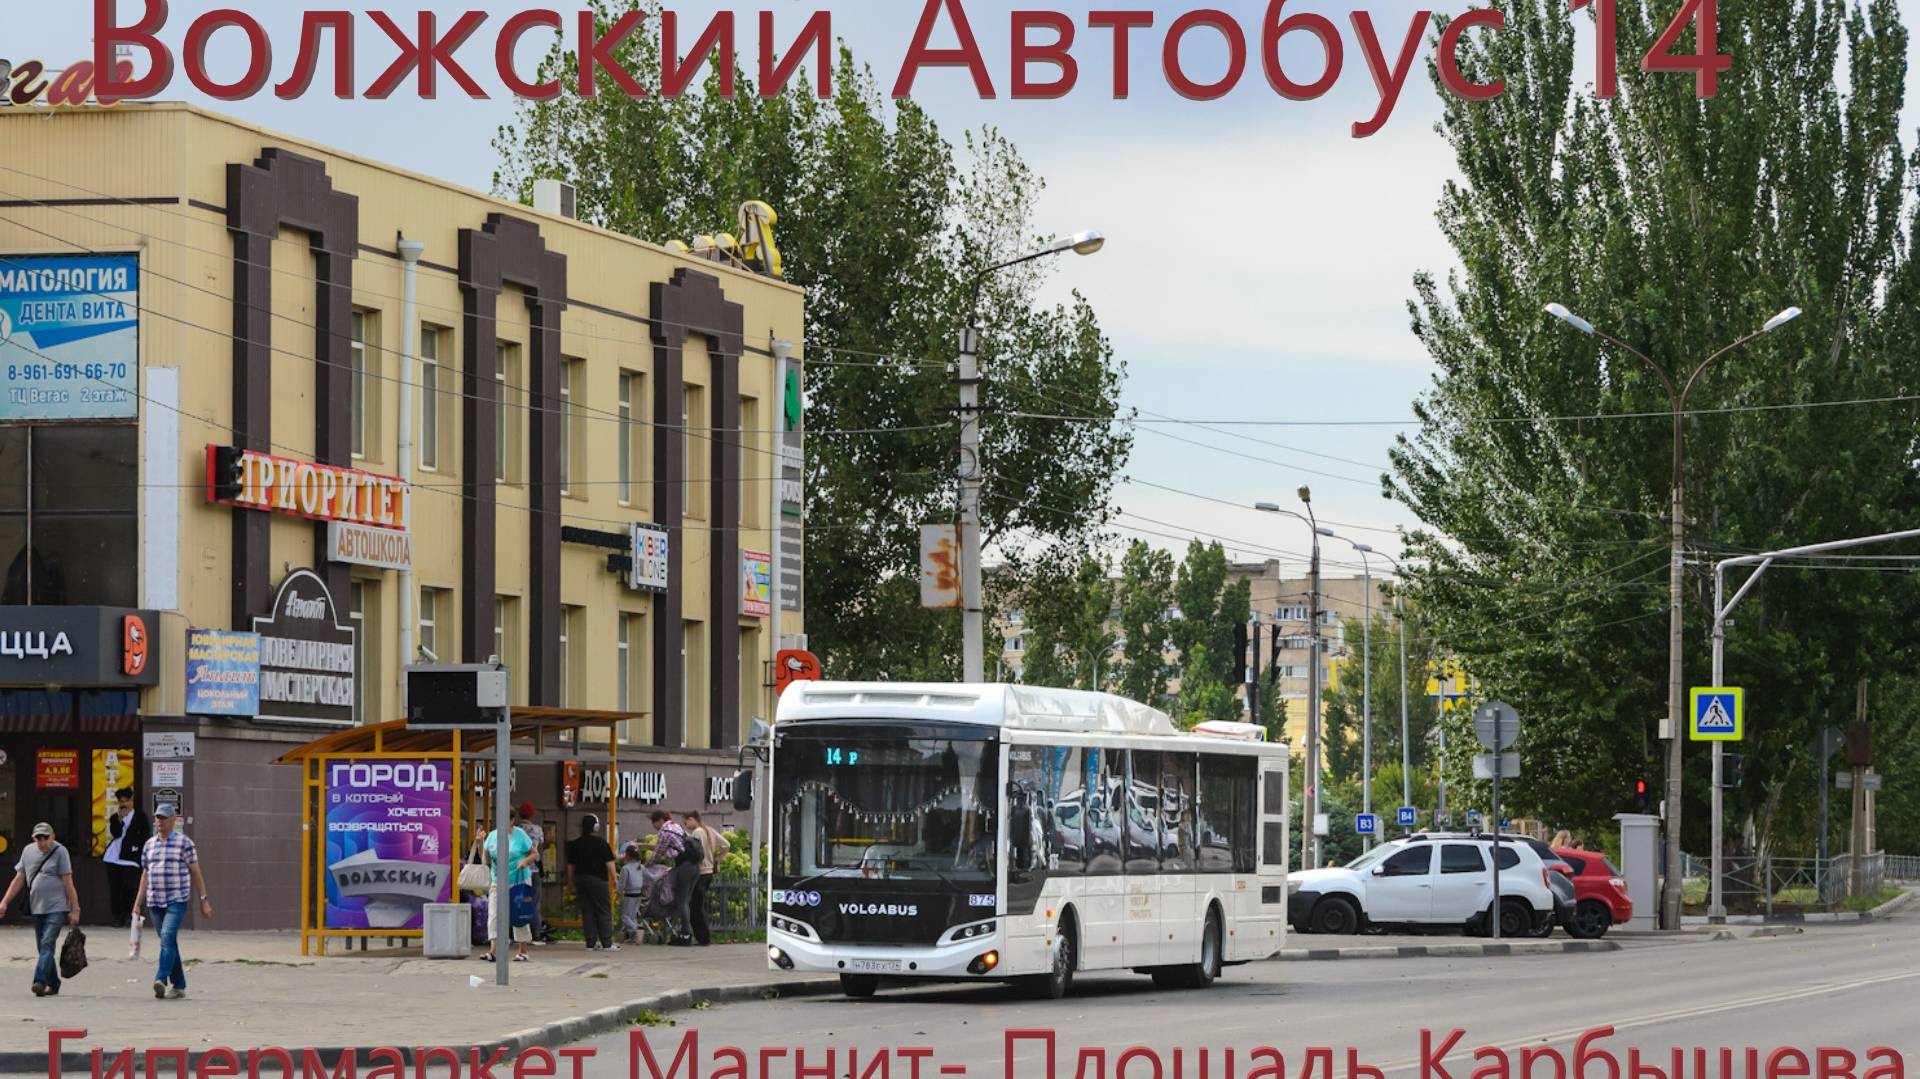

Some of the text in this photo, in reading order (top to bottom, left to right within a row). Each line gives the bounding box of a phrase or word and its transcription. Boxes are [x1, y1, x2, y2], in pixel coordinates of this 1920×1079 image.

[20, 300, 126, 323] ДЕНТА ВИТА
[9, 387, 127, 405] ТЦ Вегас 2 этаж
[236, 453, 411, 527] ПРИОРИТЕТ
[337, 527, 411, 566] АВТОШКОЛА
[1, 631, 73, 659] ЦЦА
[260, 670, 353, 706] МАСТЕРСКАЯ
[827, 747, 842, 765] 14
[332, 764, 444, 792] ГОРОД,
[622, 771, 668, 805] ПИЦЦА
[332, 792, 404, 803] В КОТОРЫЙ
[387, 807, 441, 817] ХОЧЕТСЯ
[329, 822, 423, 832] ВОЗВРАЩАТЬСЯ
[338, 867, 438, 889] ВОЛЖСКИЙ
[839, 903, 918, 916] VOLGABUS
[969, 896, 995, 906] 875
